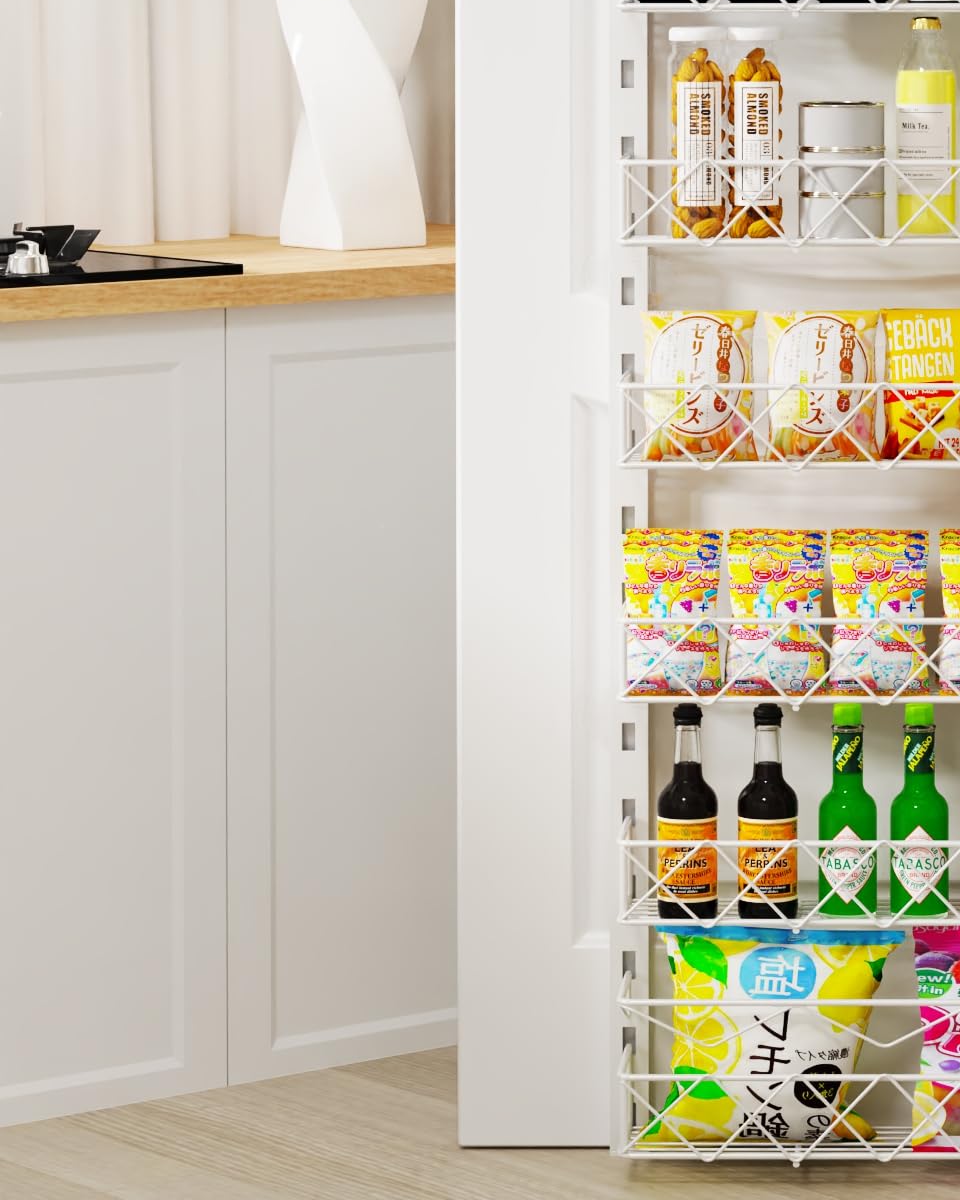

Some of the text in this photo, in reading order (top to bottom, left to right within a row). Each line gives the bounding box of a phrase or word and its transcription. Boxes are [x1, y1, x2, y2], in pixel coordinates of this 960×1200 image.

[690, 93, 699, 136] ALMOND
[701, 93, 711, 136] SMOKED
[747, 93, 757, 136] ALMOND
[758, 93, 768, 136] SMOKED
[902, 122, 916, 130] Milk
